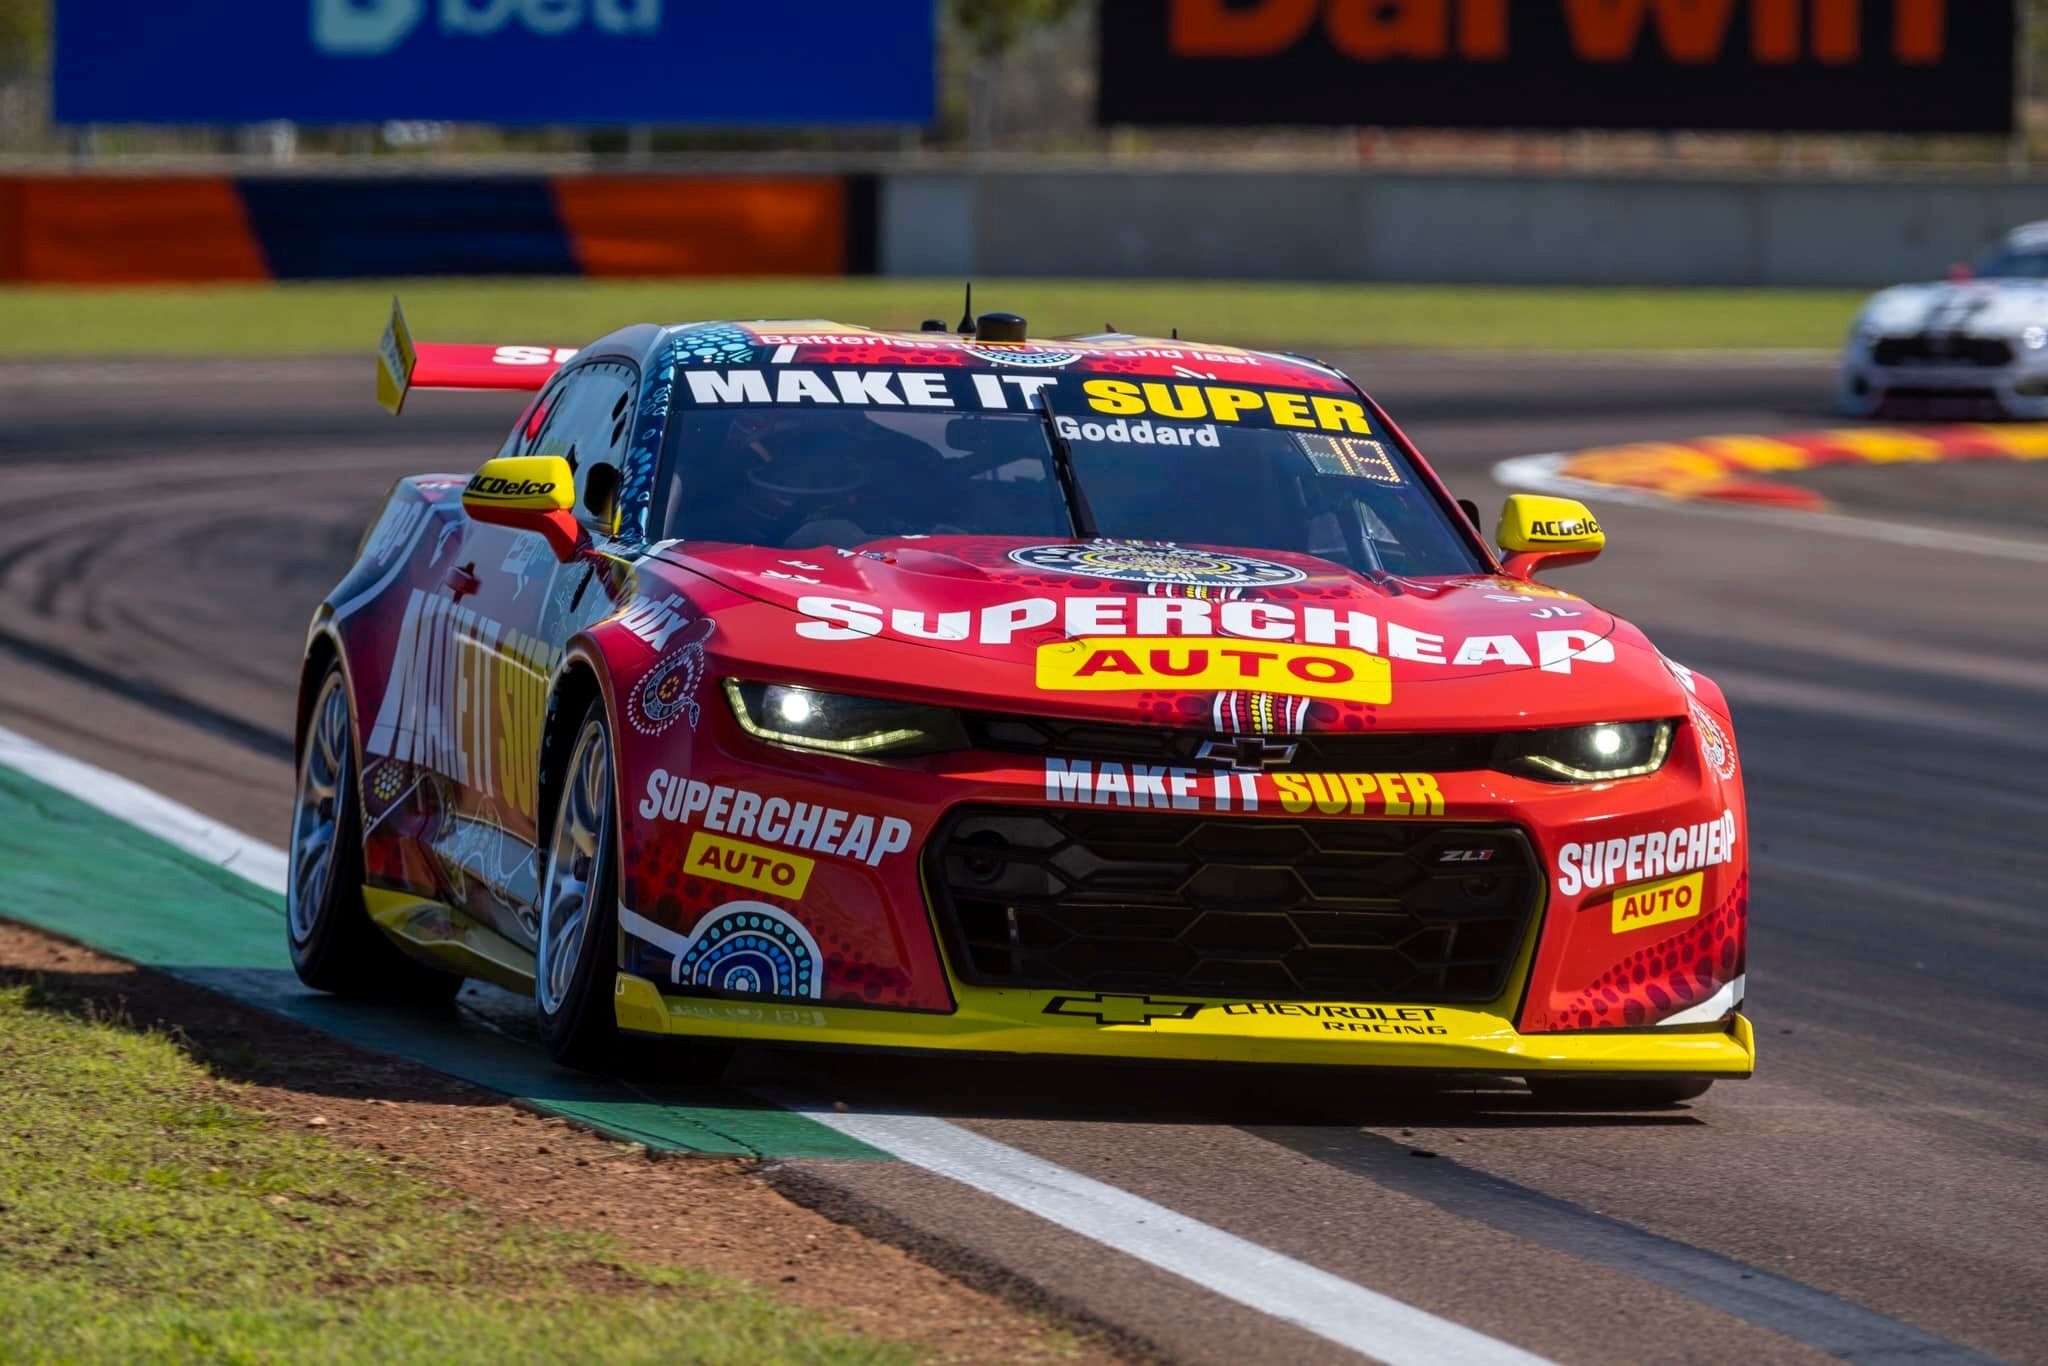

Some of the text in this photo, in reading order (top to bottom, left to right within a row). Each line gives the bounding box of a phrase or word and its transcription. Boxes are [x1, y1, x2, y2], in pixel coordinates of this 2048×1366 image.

[760, 334, 939, 349] Batteries
[1115, 348, 1180, 359] and
[1193, 351, 1262, 366] last
[685, 369, 1372, 435] MAKE IT SUPER
[1055, 416, 1220, 448] Goddard
[468, 475, 556, 495] ACDelco
[795, 596, 1615, 674] SUPERCHEAP
[1073, 648, 1356, 684] AUTO
[1045, 759, 1446, 816] MAKE IT SUPER
[639, 768, 912, 867] SUPERCHEAP
[696, 844, 796, 887] AUTO
[1557, 808, 1736, 896] SUPERCHEAP
[1621, 884, 1692, 921] AUTO
[1223, 1002, 1437, 1022] CHEVROLET
[1323, 1021, 1448, 1036] RACING
